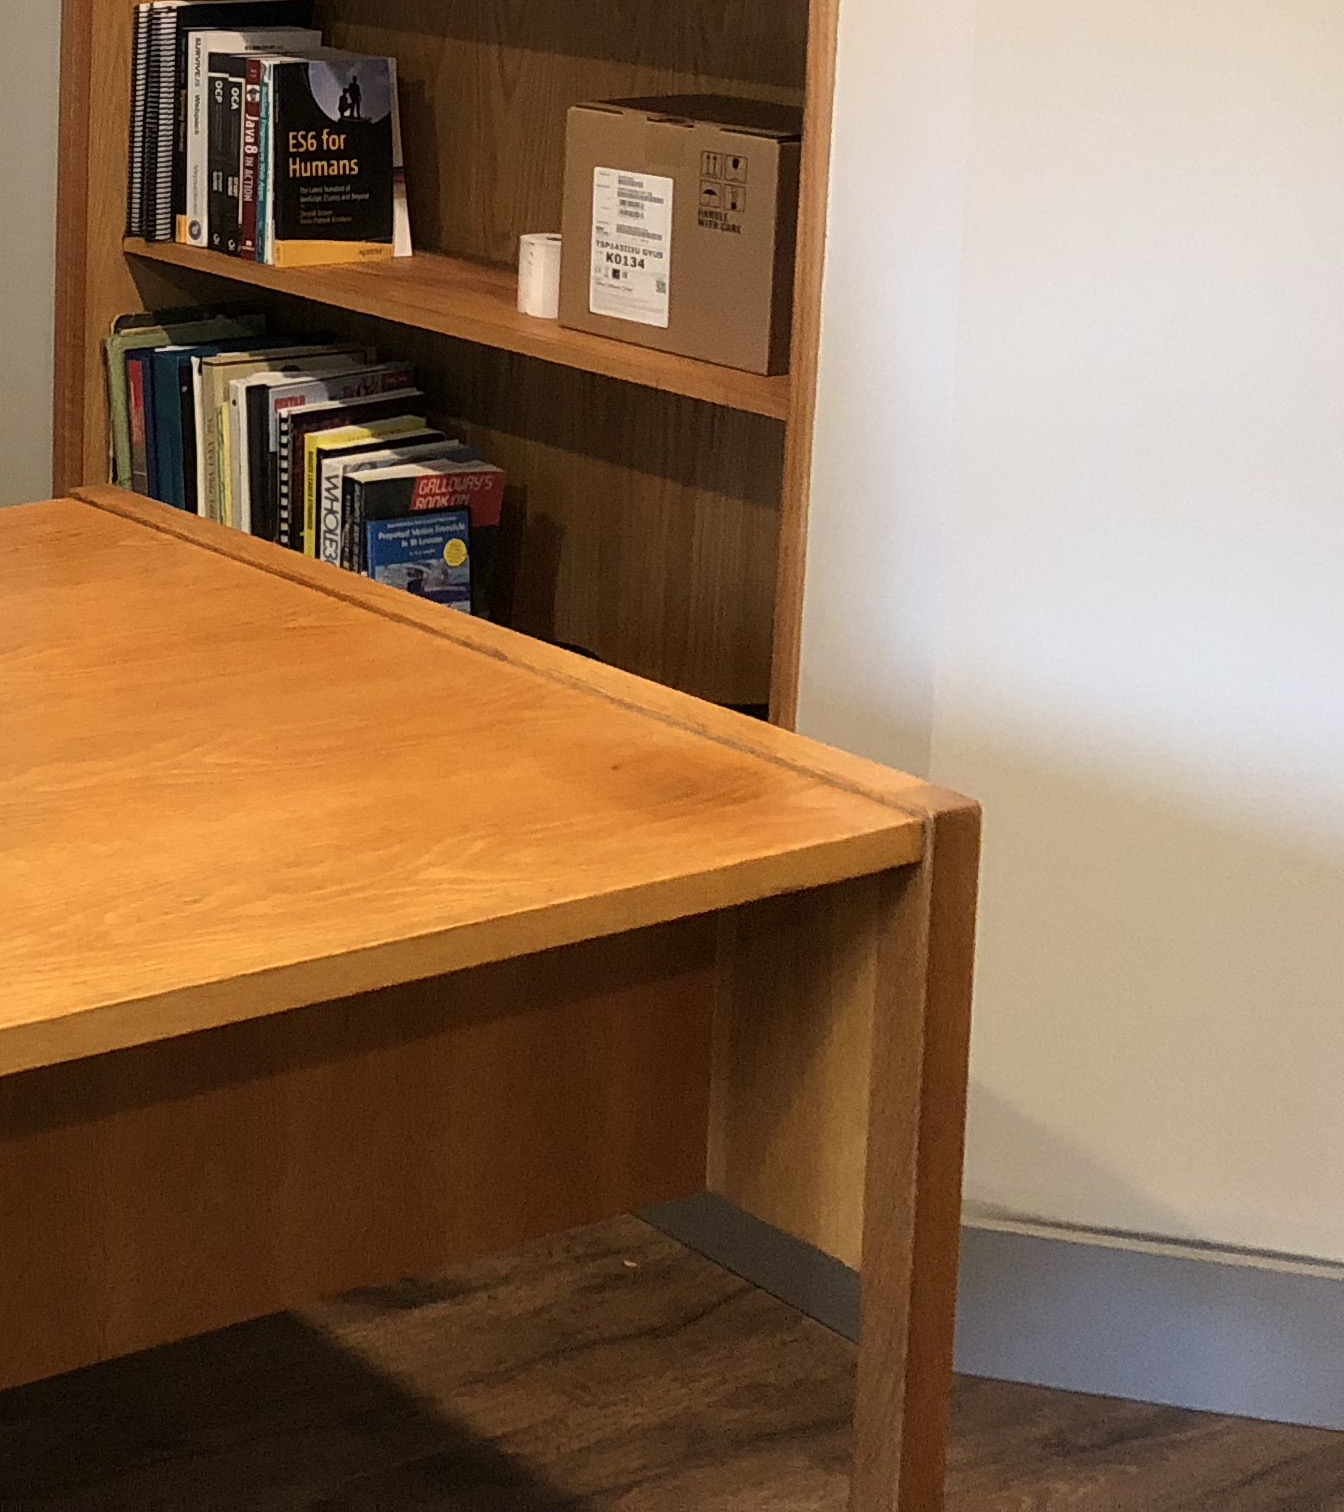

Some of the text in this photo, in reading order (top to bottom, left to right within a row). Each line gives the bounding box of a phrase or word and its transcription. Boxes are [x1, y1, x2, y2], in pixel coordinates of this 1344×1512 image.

[214, 80, 223, 103] OCP
[230, 87, 240, 110] OCA
[245, 113, 260, 142] Java
[288, 128, 347, 153] ES6 for
[288, 156, 359, 178] Humans
[244, 168, 254, 202] ACTION
[418, 474, 493, 495] GALLOWAY'S
